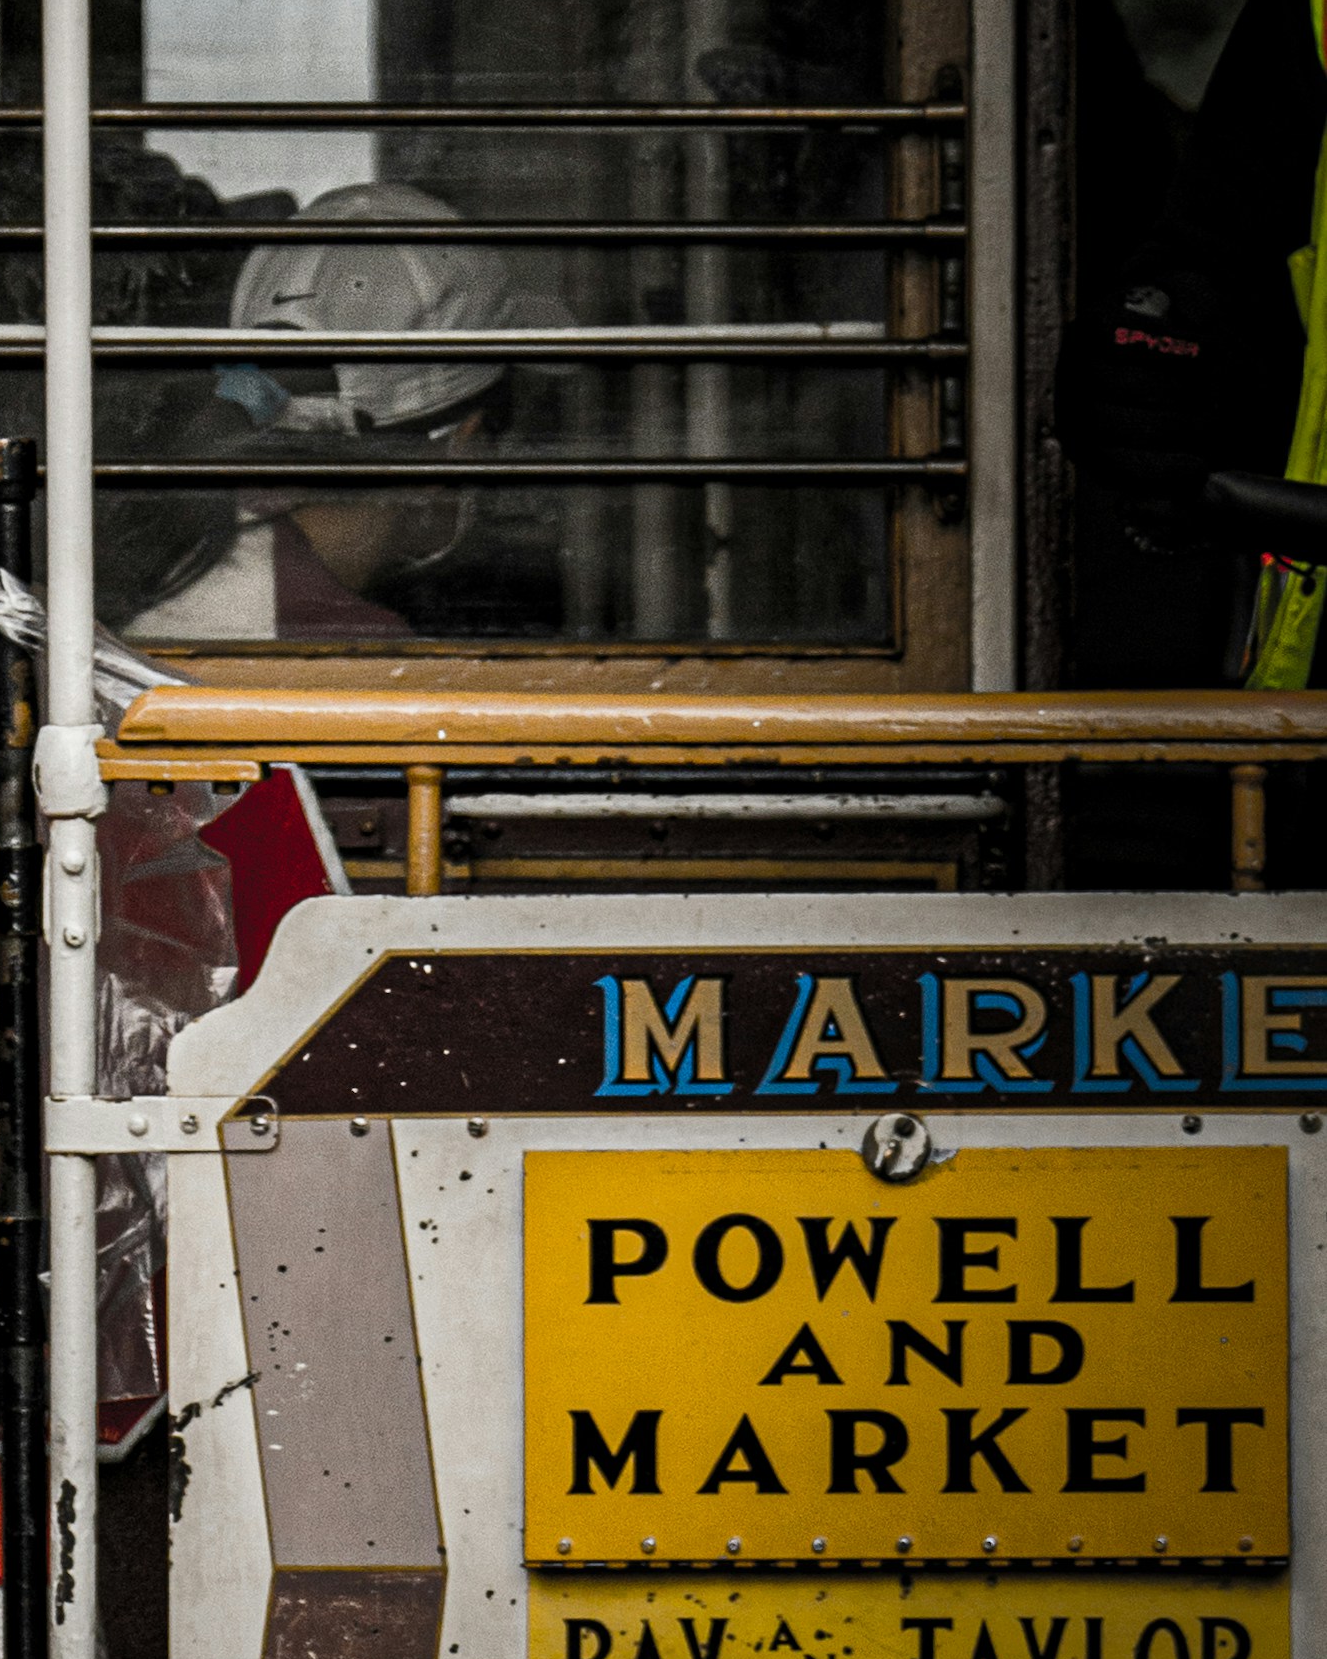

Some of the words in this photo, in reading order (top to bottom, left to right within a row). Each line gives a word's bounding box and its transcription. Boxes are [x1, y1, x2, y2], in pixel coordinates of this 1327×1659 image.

[584, 1212, 1257, 1306] POWELL
[758, 1319, 1086, 1388] AND
[566, 1406, 1266, 1496] MARKET
